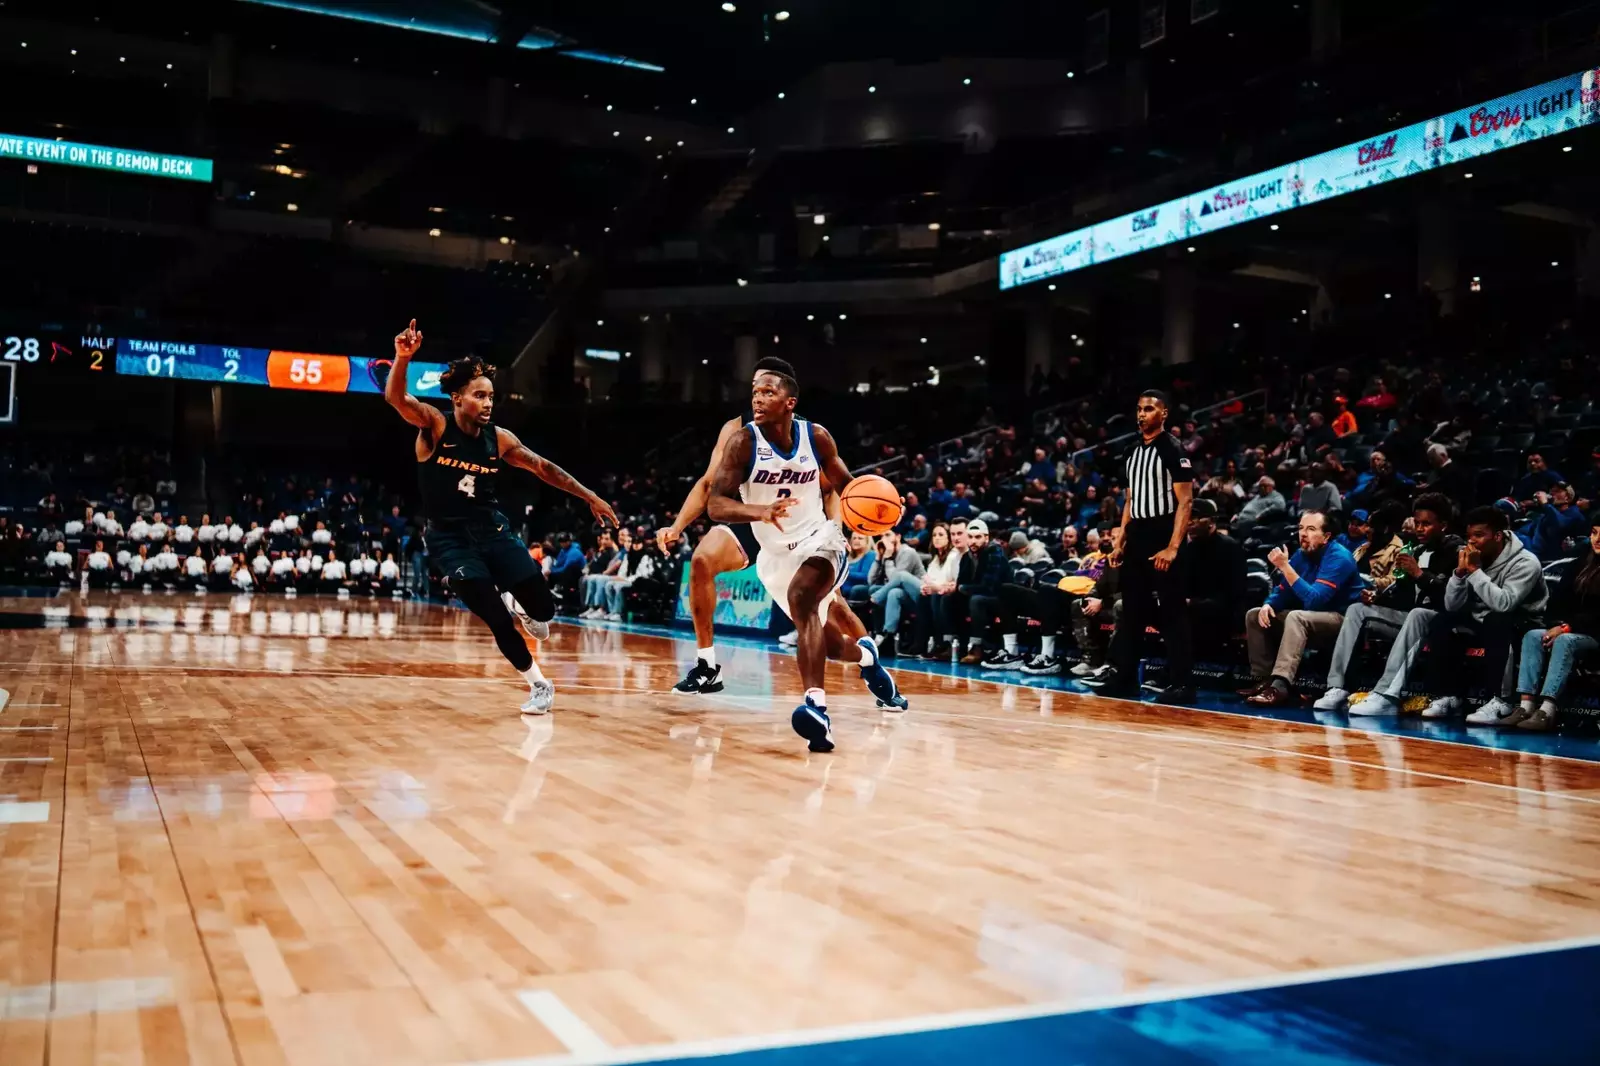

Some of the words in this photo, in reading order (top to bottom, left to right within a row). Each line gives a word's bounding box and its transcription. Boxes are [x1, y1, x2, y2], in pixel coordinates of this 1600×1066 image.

[1469, 106, 1522, 137] Coors
[1524, 89, 1575, 120] LIGHT
[27, 142, 67, 159] EVENT
[70, 147, 87, 162] ON
[91, 149, 113, 166] THE
[116, 152, 158, 171] DEMON
[162, 158, 193, 176] DECK
[1358, 134, 1398, 165] Chill
[1249, 178, 1283, 201] LIGHT
[4, 336, 39, 362] 28
[82, 336, 114, 350] HALF
[128, 339, 160, 353] TEAM
[160, 341, 196, 355] FOULS
[222, 347, 241, 359] TOL
[90, 350, 104, 371] 2
[146, 354, 175, 377] 01
[224, 360, 239, 380] 2
[289, 359, 323, 384] 55
[458, 474, 476, 498] 4
